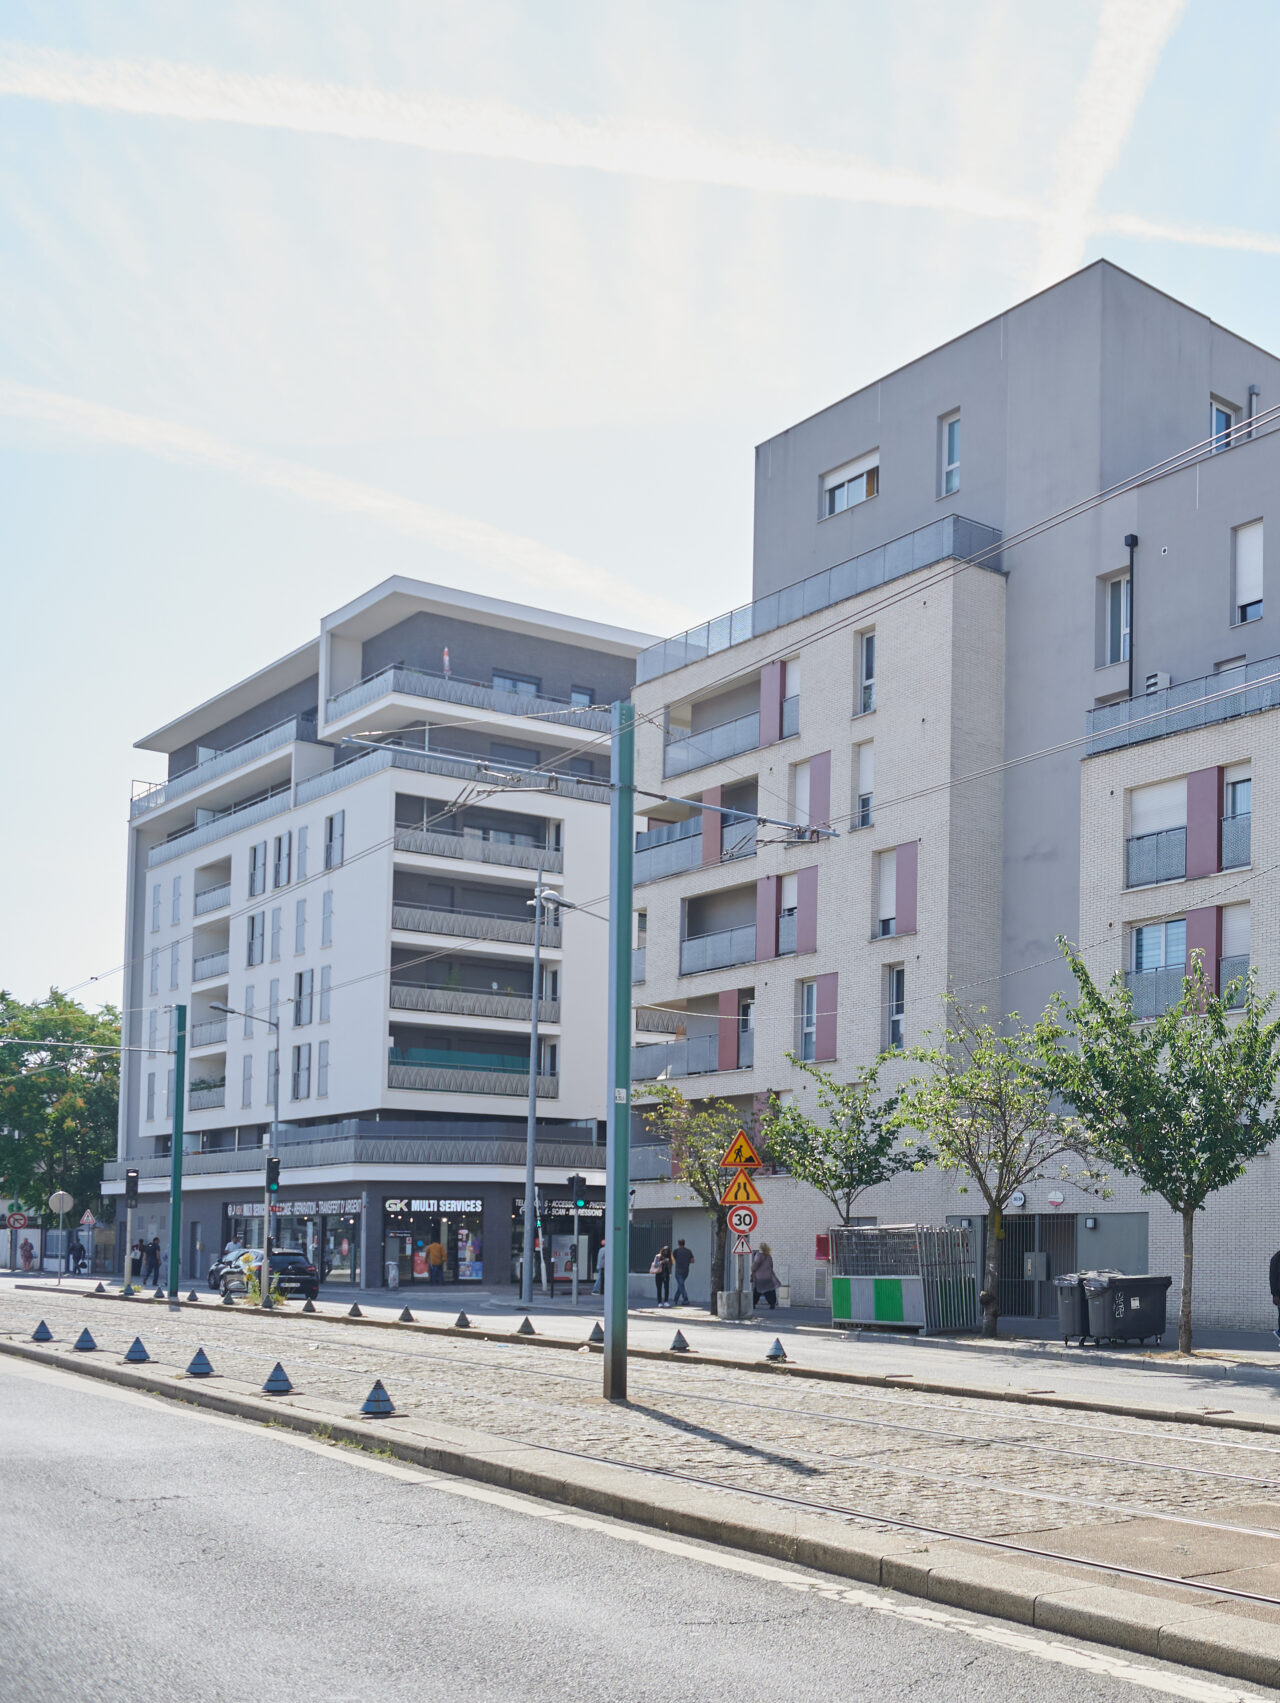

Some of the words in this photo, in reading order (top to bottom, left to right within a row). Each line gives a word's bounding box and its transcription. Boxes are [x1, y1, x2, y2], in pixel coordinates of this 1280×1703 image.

[385, 1199, 408, 1212] GK
[411, 1199, 437, 1212] MULTI
[439, 1199, 482, 1212] SERVICES
[569, 1208, 602, 1217] IMRESSIONS
[734, 1213, 752, 1226] 30
